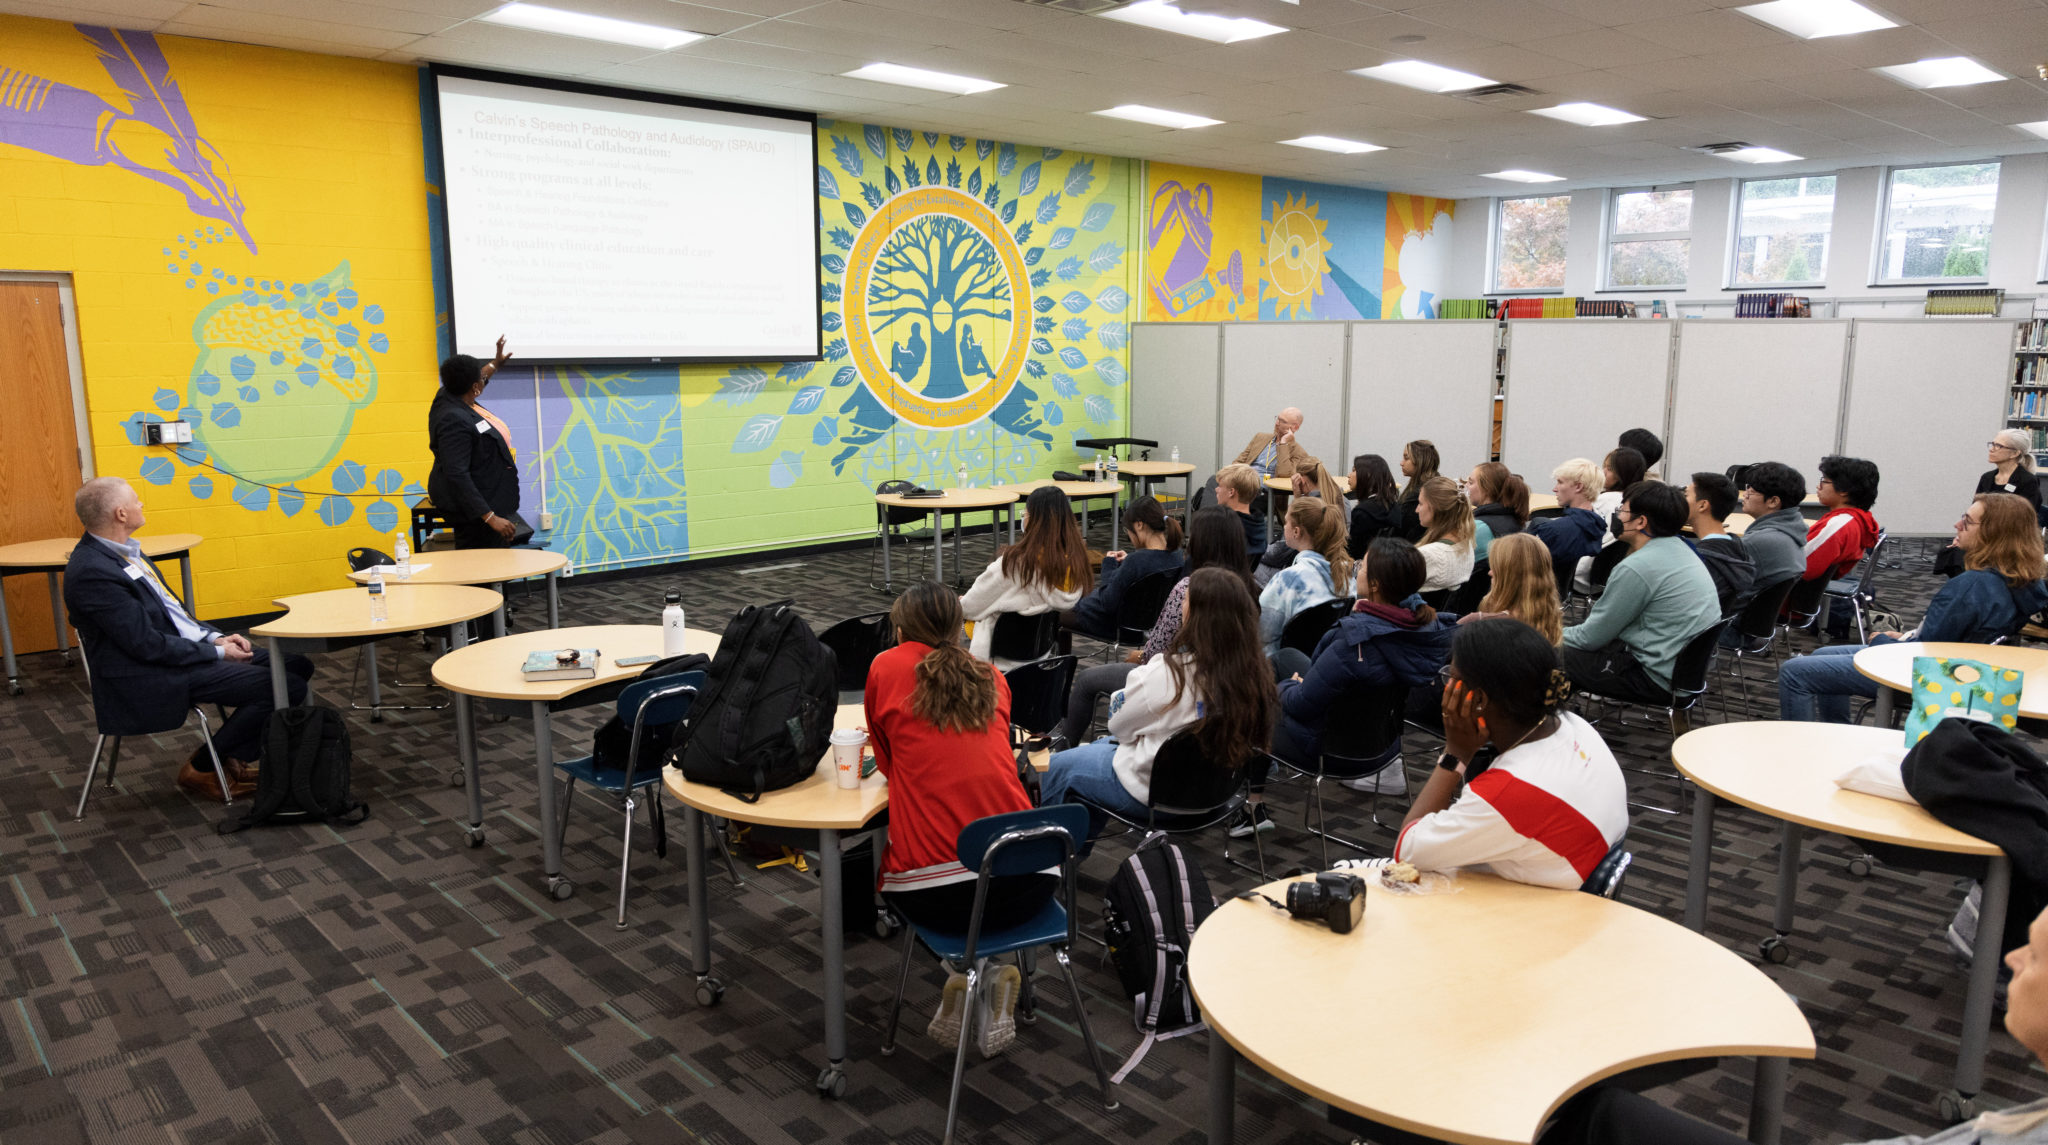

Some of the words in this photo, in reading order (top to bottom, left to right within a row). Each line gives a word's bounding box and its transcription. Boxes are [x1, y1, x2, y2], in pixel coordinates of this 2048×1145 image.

[469, 127, 582, 150] Interprofessional
[586, 138, 671, 159] Collaboration:
[474, 110, 526, 128] Calvin's
[531, 117, 578, 135] Speech
[583, 122, 642, 142] Pathology
[646, 131, 667, 144] and
[670, 133, 723, 151] Audiology
[727, 137, 776, 156] (SPAUD)
[471, 165, 516, 182] Strong
[519, 172, 582, 186] programs
[583, 176, 594, 185] at
[596, 175, 612, 187] all
[615, 176, 652, 191] levels:
[913, 196, 925, 207] for
[926, 194, 965, 209] Excellence
[476, 234, 509, 250] High
[512, 236, 555, 251] quality
[559, 239, 604, 253] clinical
[667, 244, 689, 256] and
[859, 229, 880, 258] Others
[851, 259, 868, 296] Serving
[1004, 242, 1023, 293] Community
[852, 314, 863, 342] Truth
[860, 341, 879, 379] Seeking
[937, 401, 978, 418] Developing
